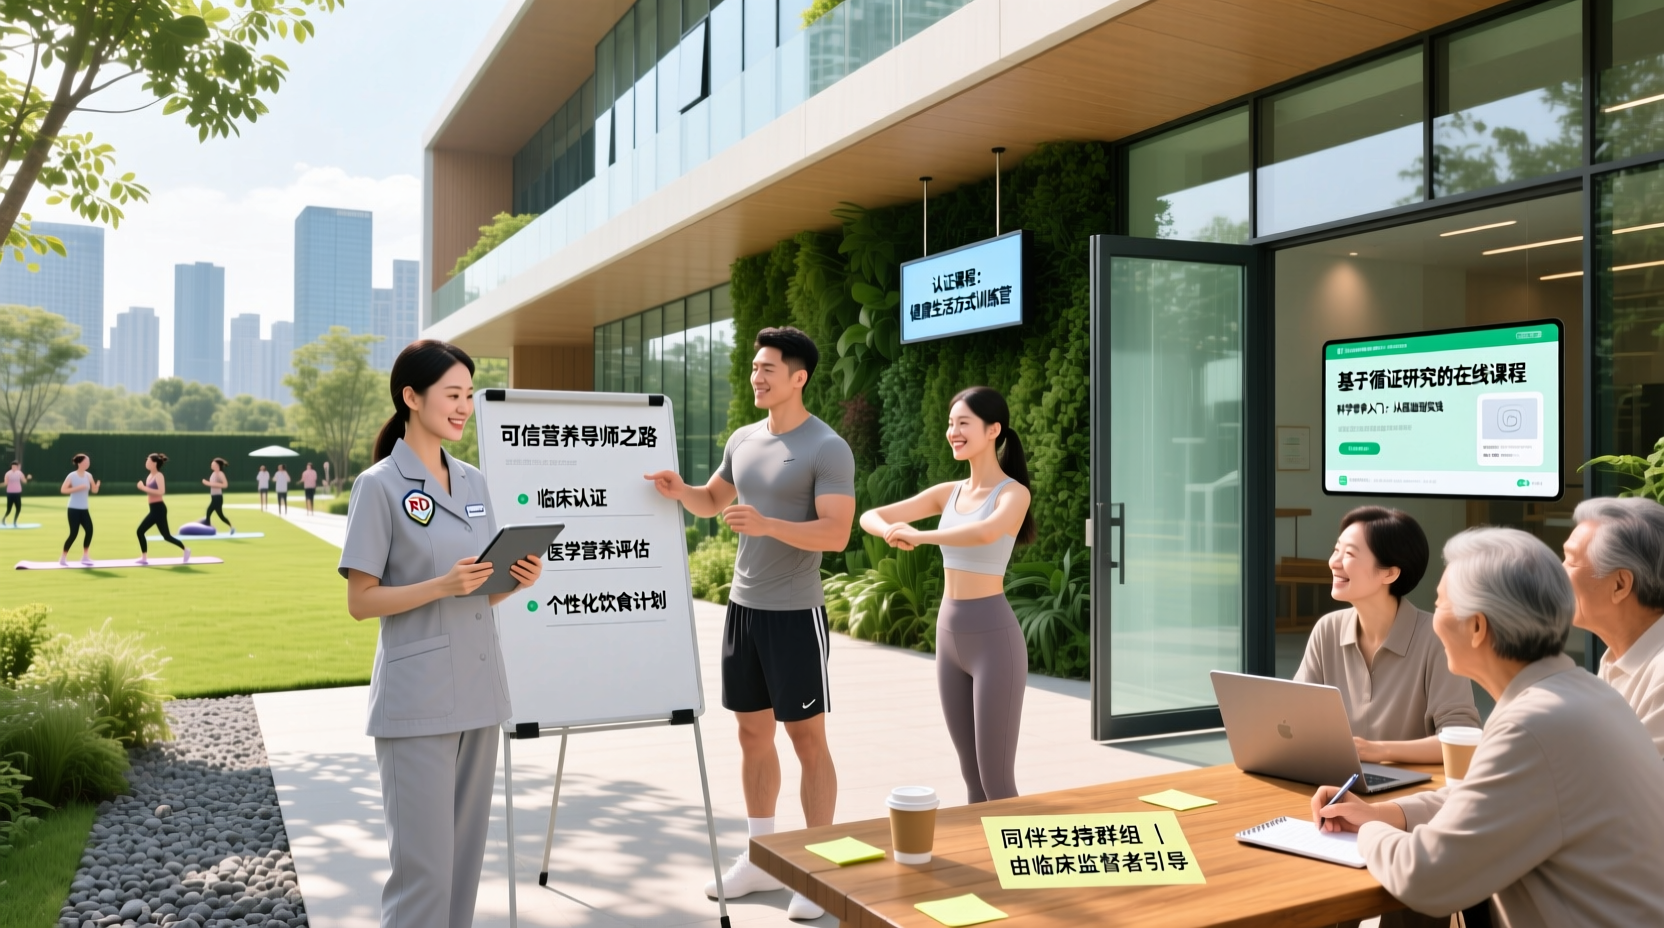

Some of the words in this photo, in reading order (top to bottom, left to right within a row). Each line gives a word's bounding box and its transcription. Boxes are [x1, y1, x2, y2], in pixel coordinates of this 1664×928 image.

[1337, 362, 1527, 392] 基于循证研究的在线课程
[500, 424, 658, 448] 可信营养导师之路
[537, 488, 608, 509] 临床认证
[547, 539, 650, 562] 医学营养评估
[546, 590, 667, 615] 个性化饮食计划
[1010, 850, 1189, 876] 由临床监督者引导
